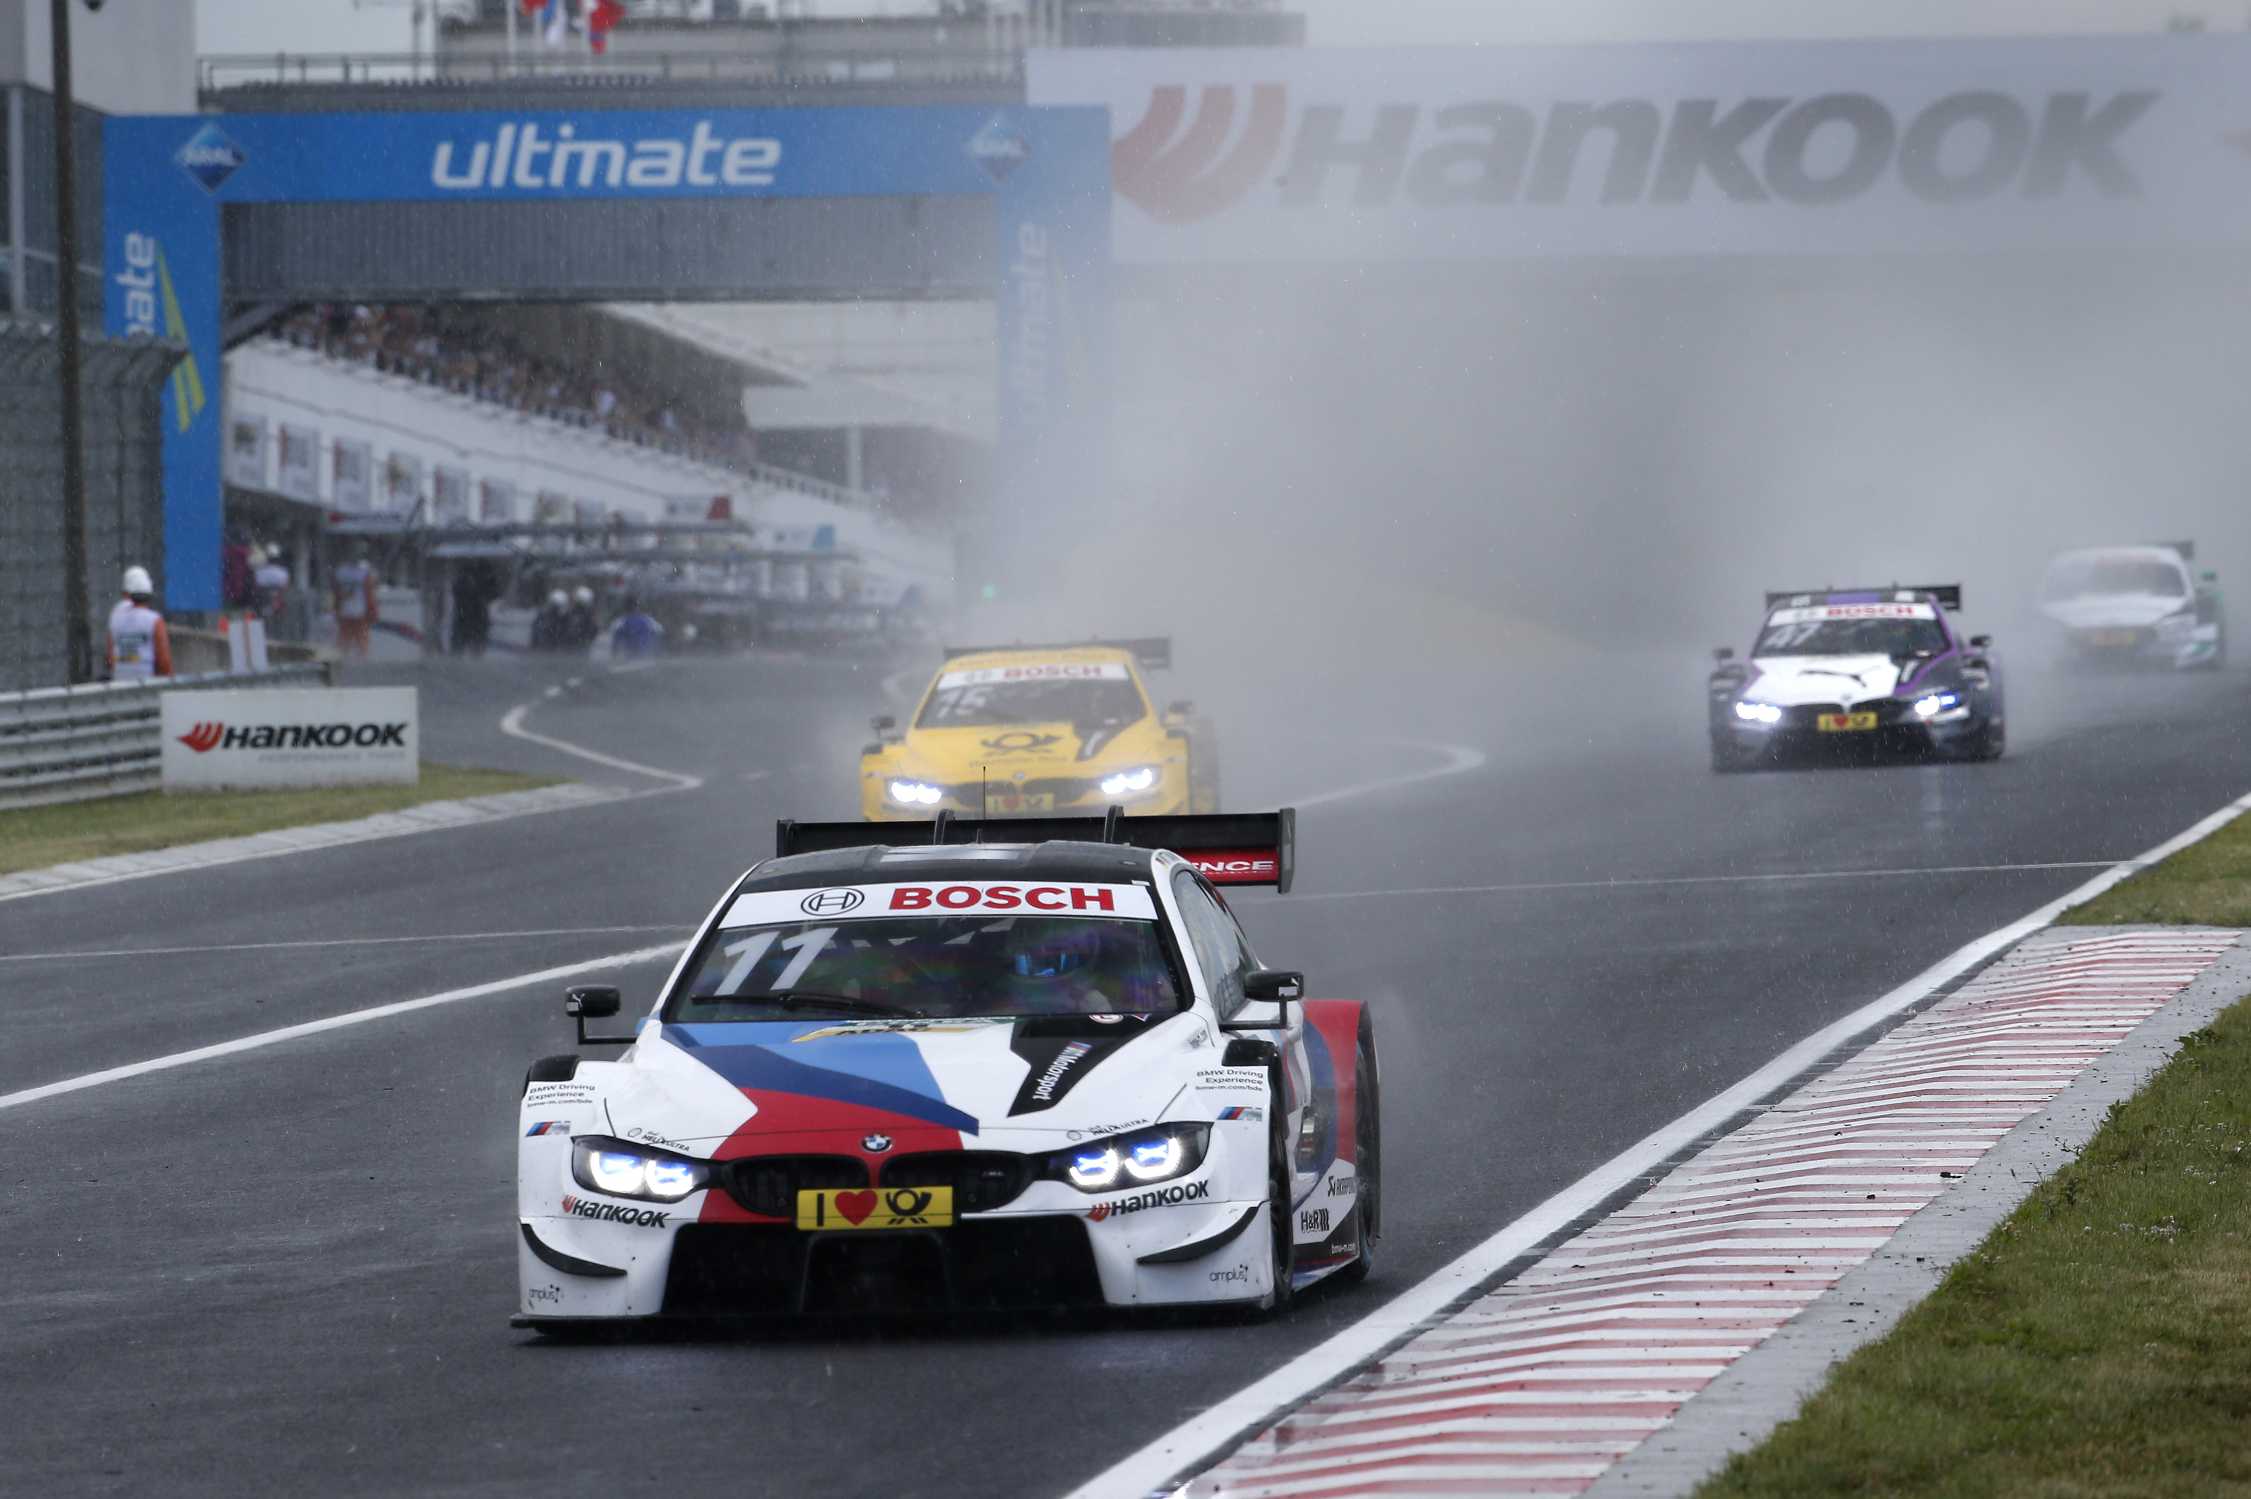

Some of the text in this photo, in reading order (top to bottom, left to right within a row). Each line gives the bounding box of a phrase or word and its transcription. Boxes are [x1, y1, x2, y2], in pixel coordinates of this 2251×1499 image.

[431, 120, 782, 188] ultimate
[1826, 606, 1914, 617] BOSCH
[1003, 665, 1101, 680] BOSCH
[889, 886, 1115, 911] BOSCH
[713, 927, 839, 997] 11
[1197, 1069, 1264, 1079] BMW Driving
[1206, 1077, 1264, 1085] Experience
[530, 1084, 596, 1094] BMW Driving
[528, 1091, 585, 1101] Experience
[816, 1193, 825, 1227] I
